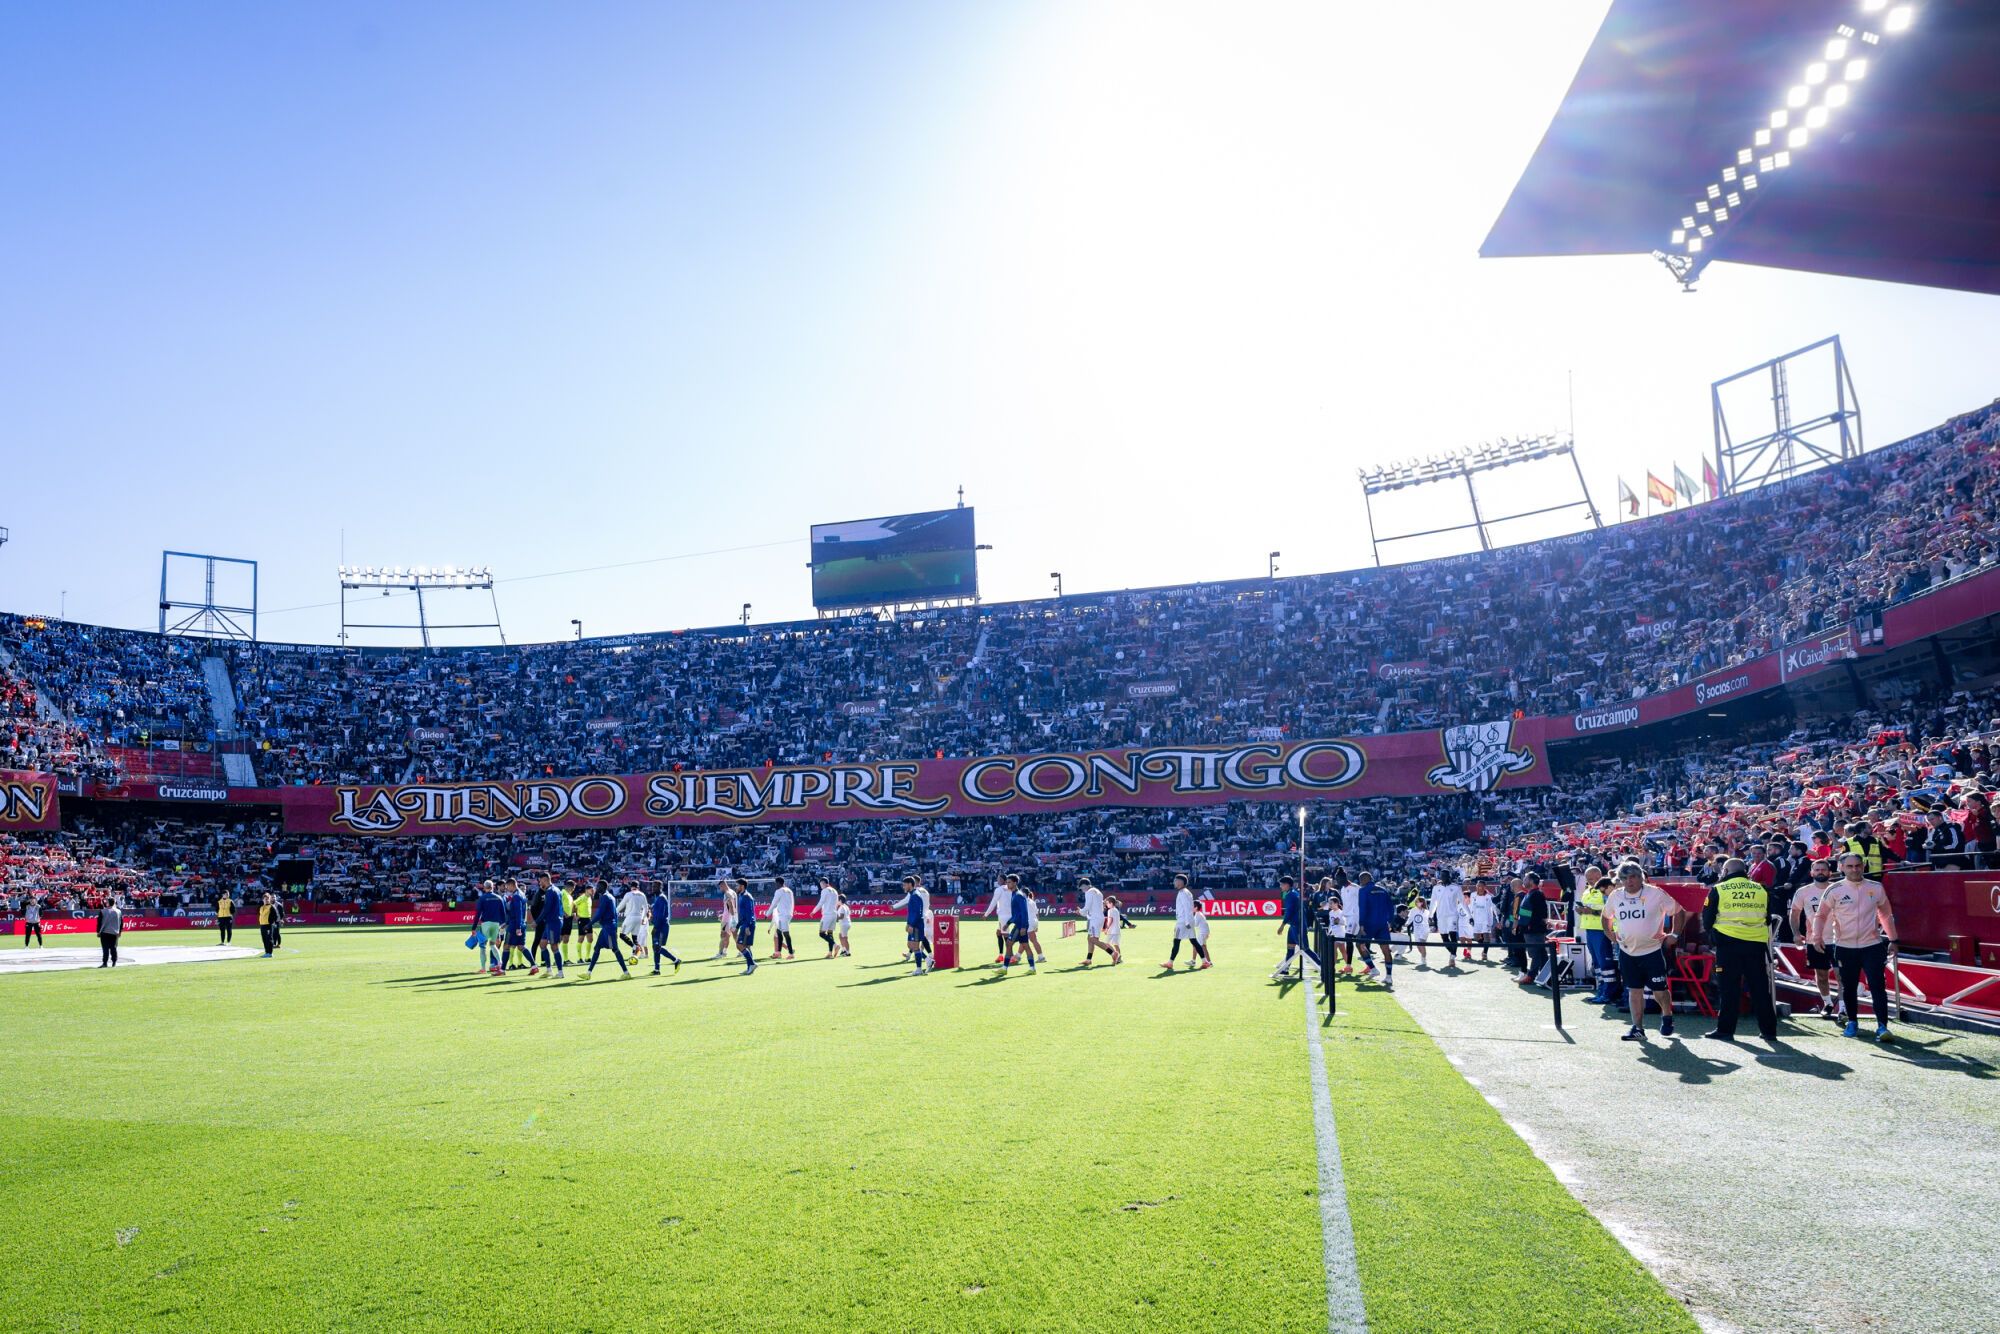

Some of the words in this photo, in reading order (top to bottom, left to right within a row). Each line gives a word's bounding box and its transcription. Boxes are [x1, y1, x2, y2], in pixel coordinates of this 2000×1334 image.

[1129, 685, 1176, 694] Cruzcampo
[1706, 675, 1748, 699] socios.com
[1575, 706, 1638, 731] Cruzcampo
[334, 778, 625, 830] LATIENDO
[646, 765, 949, 817] SIEMPRE
[962, 741, 1366, 801] CONTIGO
[159, 785, 226, 801] Cruzcampo
[690, 908, 714, 918] renfe
[934, 906, 960, 916] renfe
[1037, 906, 1056, 916] enfe
[1127, 904, 1156, 915] renfe
[1202, 902, 1258, 915] LALIGA
[338, 913, 358, 924] renfe
[393, 912, 414, 923] renfe
[1619, 910, 1645, 920] DIGI
[191, 917, 213, 928] renfe
